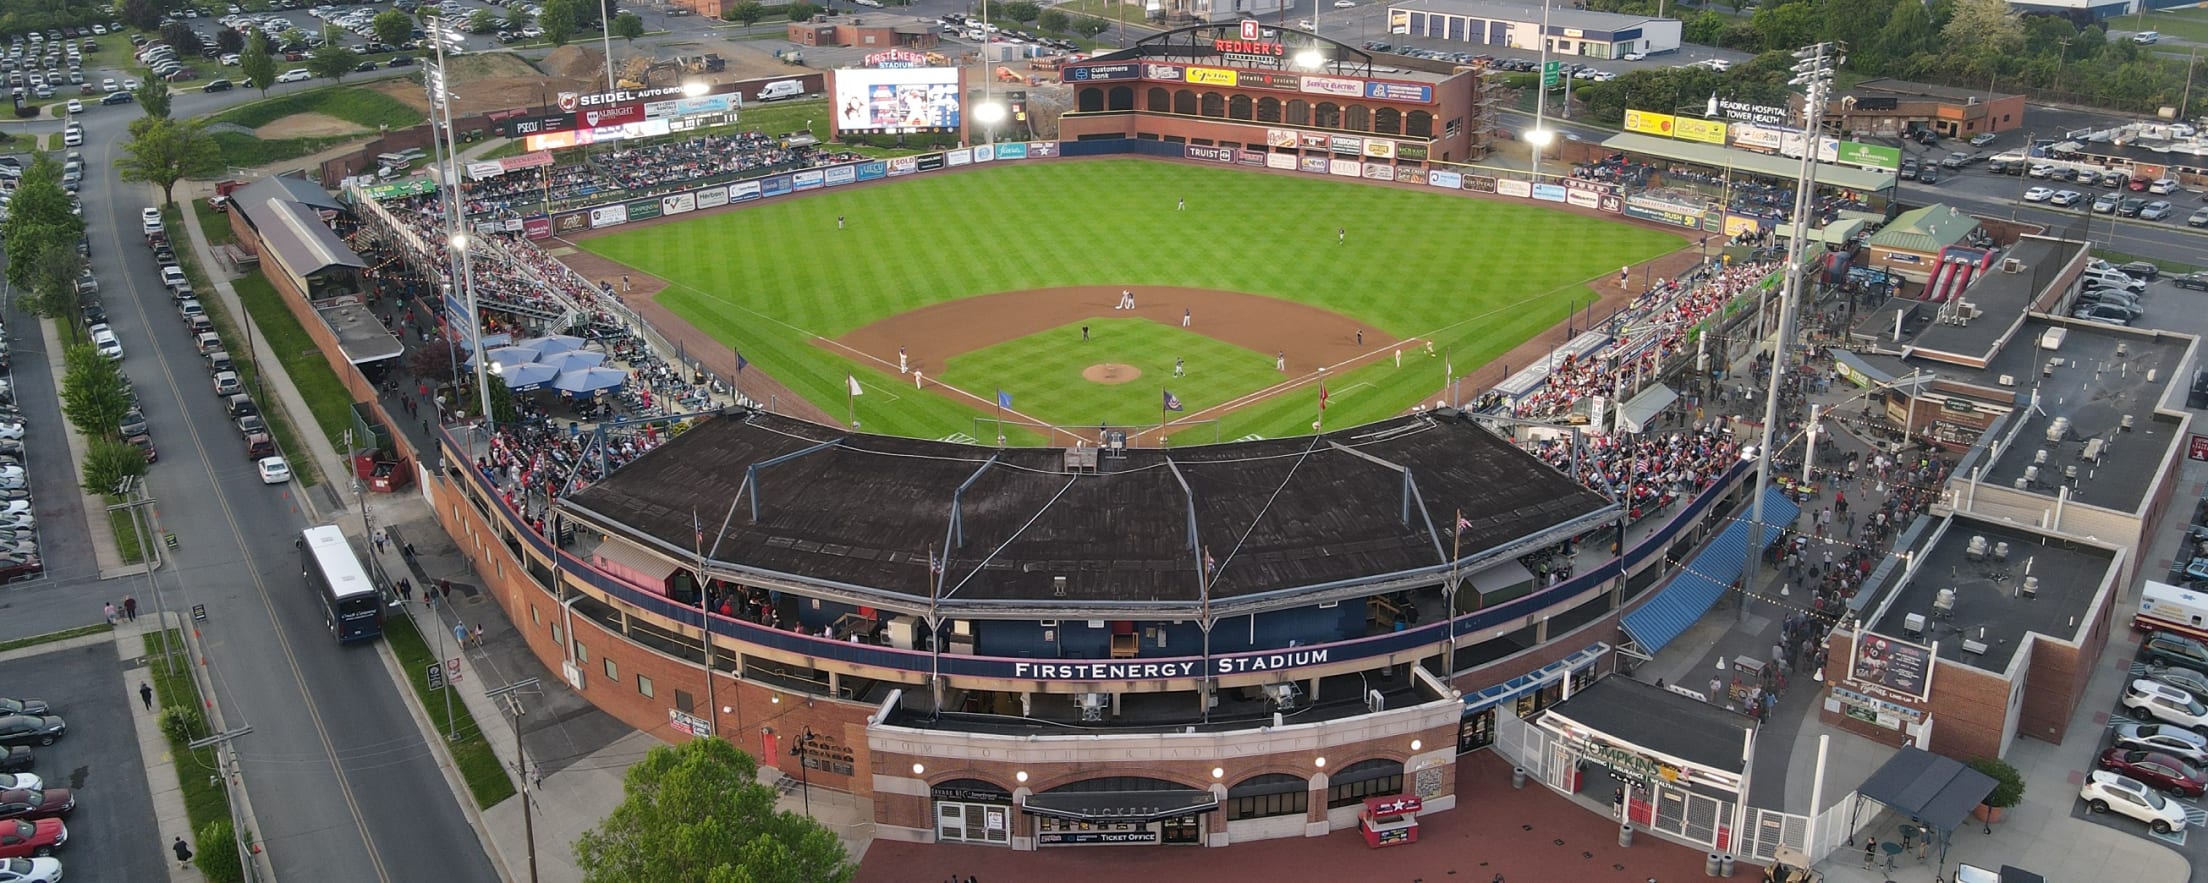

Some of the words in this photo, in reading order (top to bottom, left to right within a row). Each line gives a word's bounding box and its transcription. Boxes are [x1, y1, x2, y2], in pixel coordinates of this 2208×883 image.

[1245, 24, 1255, 36] R
[1216, 39, 1283, 56] REDNER'S
[865, 49, 927, 66] FIRSTENERGY
[1330, 82, 1356, 92] ELECTRIC
[580, 91, 636, 106] SEIDEL
[638, 88, 661, 98] AUTO
[598, 106, 634, 118] ALBRIGHT
[1720, 101, 1750, 113] READING
[1752, 105, 1787, 117] HOSPITAL
[1726, 110, 1751, 121] TOWER
[1753, 113, 1780, 124] HEALTH
[517, 121, 538, 134] PSECU
[1190, 147, 1218, 159] TRUIST
[896, 158, 914, 166] SOLD
[1664, 212, 1681, 222] RUSH
[1015, 662, 1194, 679] FIRSTENERGY
[1218, 649, 1328, 673] STADIUM
[1583, 740, 1660, 776] TOMPKINS
[1582, 754, 1607, 767] BANKING
[1613, 765, 1645, 780] INSURANCE
[1610, 773, 1642, 787] PLAZA
[1082, 807, 1160, 817] TICKETS
[1101, 833, 1127, 841] TICKET
[1128, 833, 1155, 841] OFFICE
